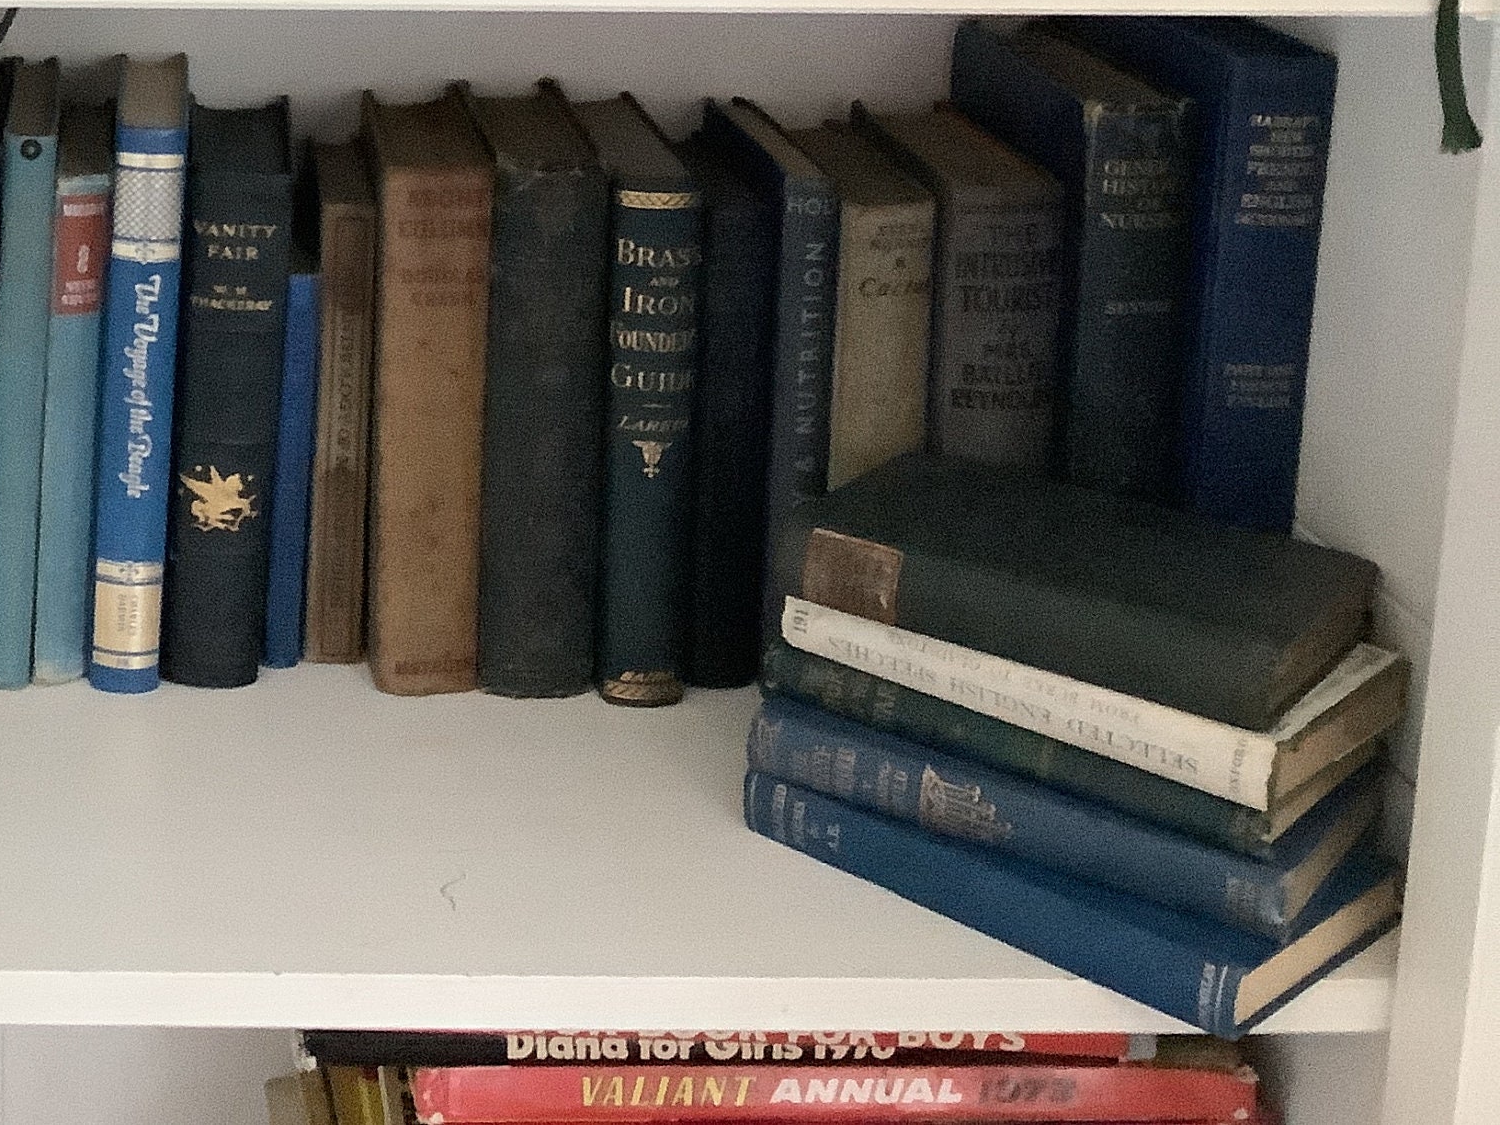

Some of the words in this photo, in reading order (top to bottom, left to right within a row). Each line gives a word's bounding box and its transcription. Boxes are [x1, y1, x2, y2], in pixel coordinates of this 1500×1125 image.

[193, 219, 278, 240] VANITY
[207, 243, 260, 262] FAIR
[134, 273, 162, 315] The
[622, 286, 696, 316] IRON
[123, 314, 162, 388] Voyage
[122, 389, 155, 409] of
[129, 408, 155, 435] the
[118, 433, 154, 500] Beagle
[948, 676, 1053, 727] ENGLISH
[1067, 718, 1199, 776] SELECTED
[580, 1073, 758, 1108] VALIANT
[769, 1077, 963, 1106] ANNUAL
